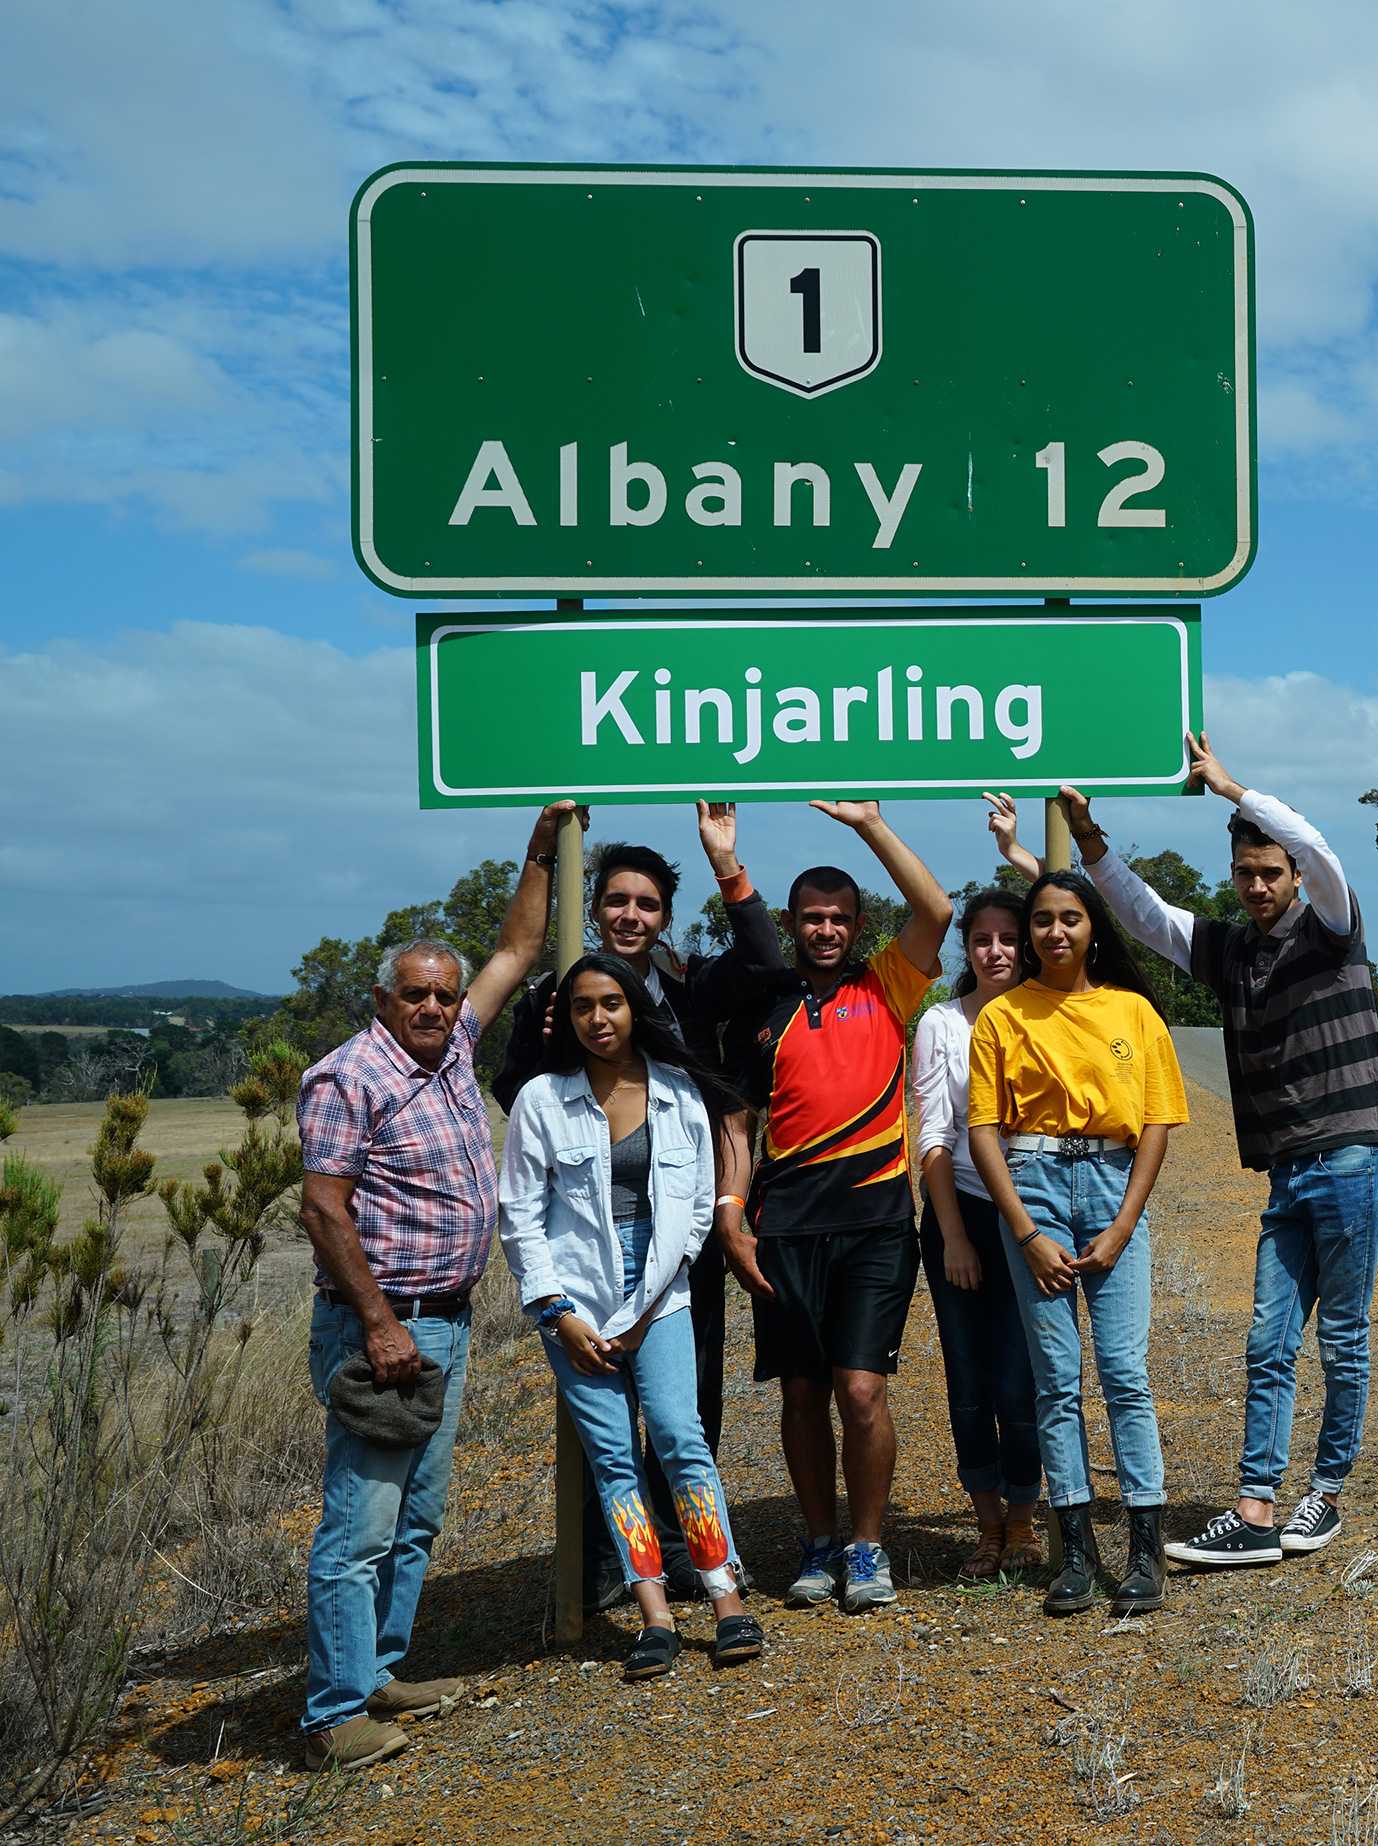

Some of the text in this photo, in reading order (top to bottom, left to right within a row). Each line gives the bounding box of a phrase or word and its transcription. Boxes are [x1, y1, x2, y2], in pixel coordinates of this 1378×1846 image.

[789, 267, 822, 354] 1
[447, 440, 1167, 549] Albany 12
[580, 664, 1043, 765] Kinjarling
